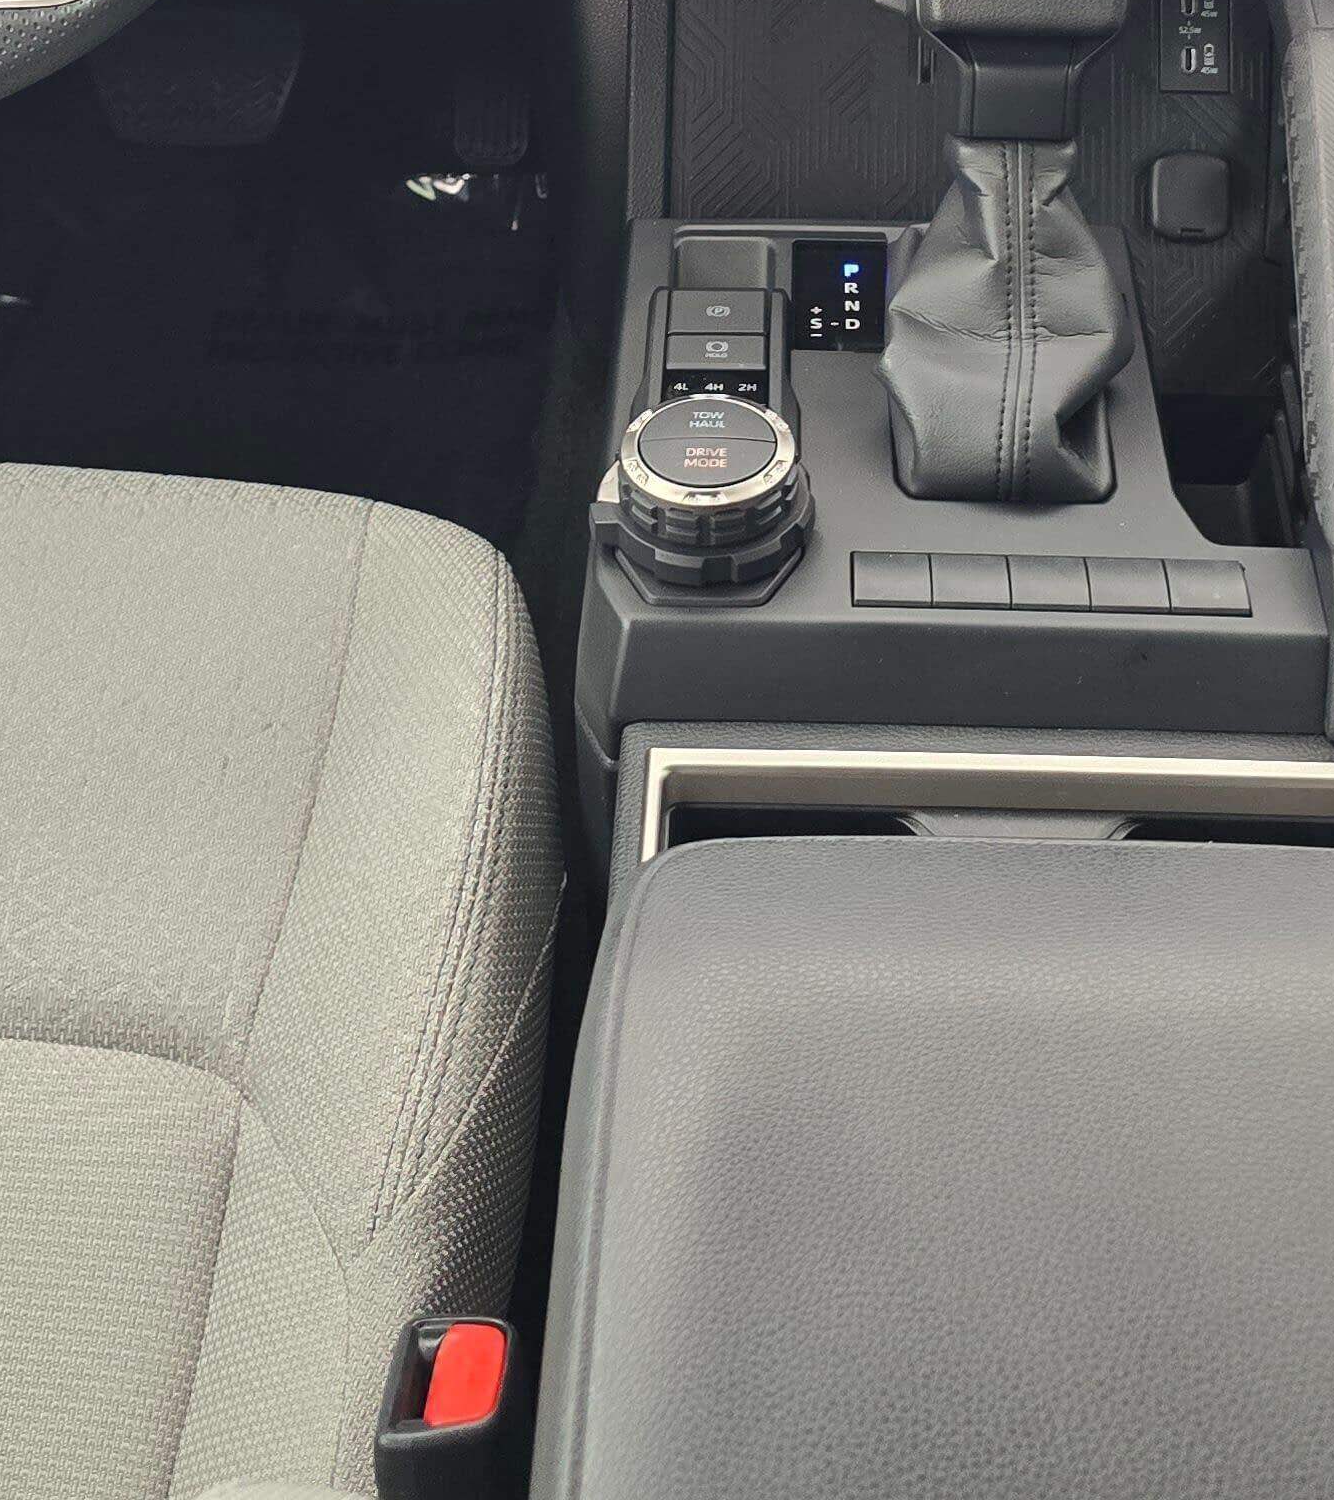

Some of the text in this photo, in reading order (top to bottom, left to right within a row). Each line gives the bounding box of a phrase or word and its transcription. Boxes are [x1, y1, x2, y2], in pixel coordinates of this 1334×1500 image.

[843, 263, 860, 277] P
[844, 282, 859, 294] R
[844, 300, 860, 312] N
[810, 318, 823, 330] S
[845, 318, 861, 330] D
[673, 383, 757, 392] 4L 4H 2H
[692, 411, 725, 419] TOW
[689, 421, 726, 429] HAUL
[685, 447, 728, 457] DRIVE
[683, 458, 728, 468] MODE
